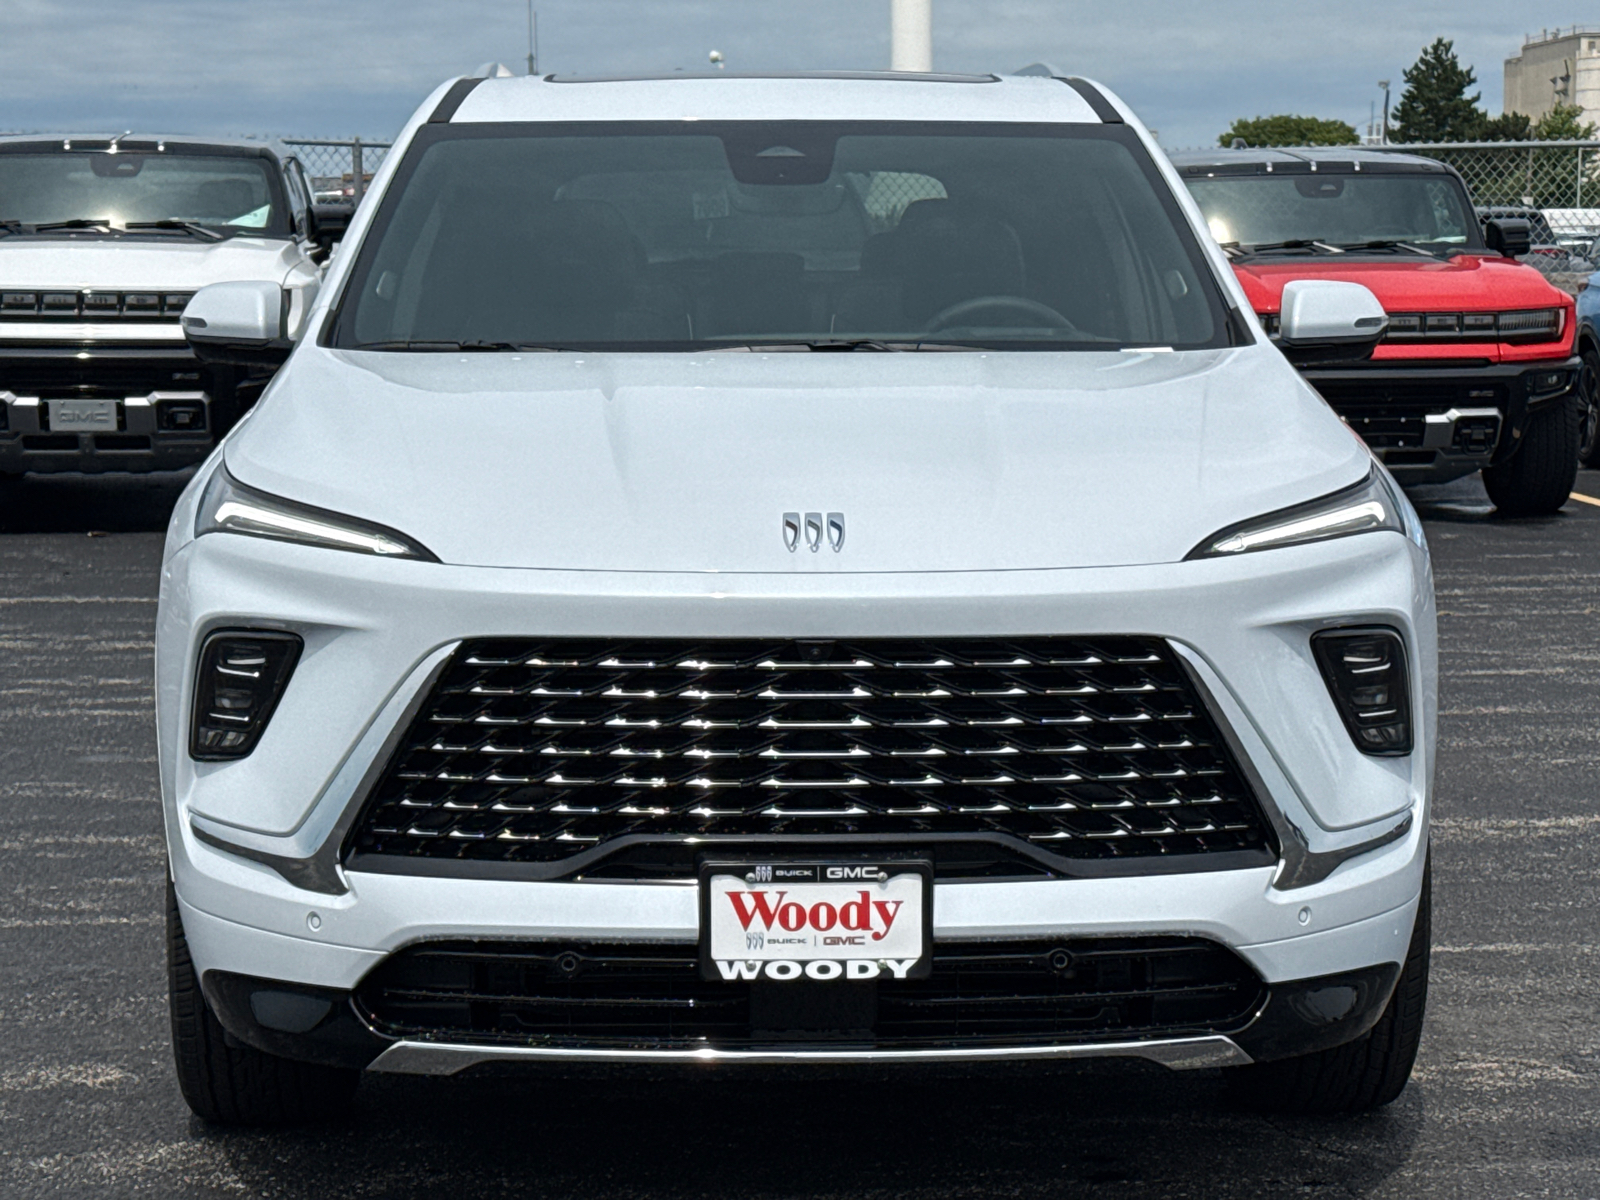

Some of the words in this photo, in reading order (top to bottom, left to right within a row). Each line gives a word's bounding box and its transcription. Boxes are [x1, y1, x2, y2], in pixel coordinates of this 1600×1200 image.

[826, 867, 879, 879] GMC
[724, 890, 904, 941] Woody
[823, 936, 866, 946] GMC
[715, 959, 919, 980] WOODY
